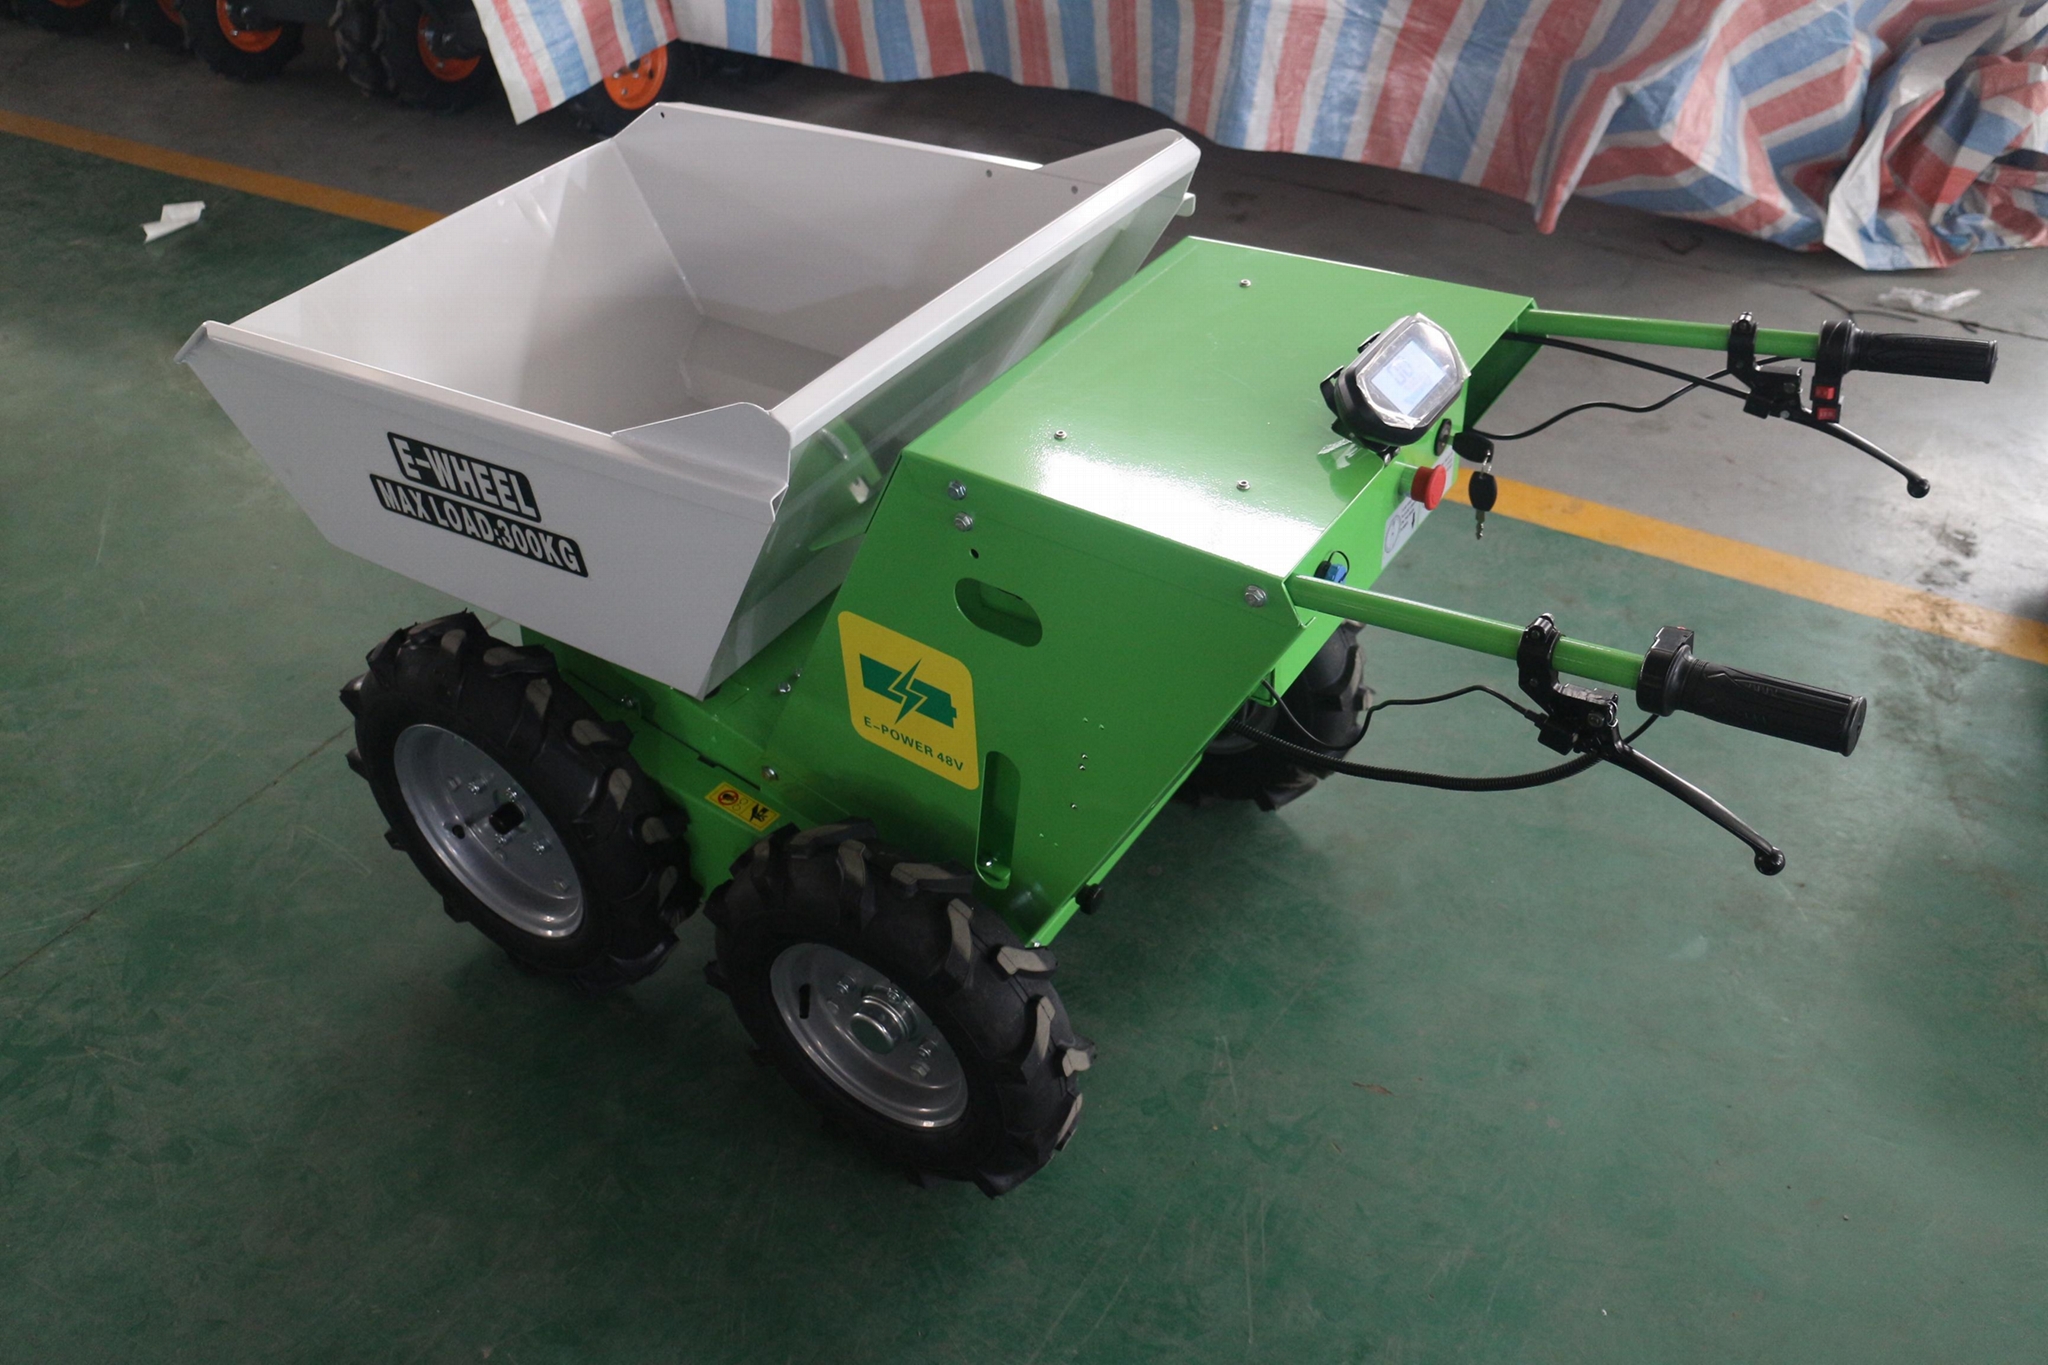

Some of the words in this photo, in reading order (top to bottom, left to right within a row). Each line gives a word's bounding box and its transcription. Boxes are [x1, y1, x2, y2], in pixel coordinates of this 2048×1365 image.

[392, 437, 537, 519] E-WHEEL
[376, 478, 432, 522] MAX
[428, 495, 581, 573] LOAD:300KG
[863, 715, 934, 758] E-POWER
[936, 752, 964, 771] 48V
